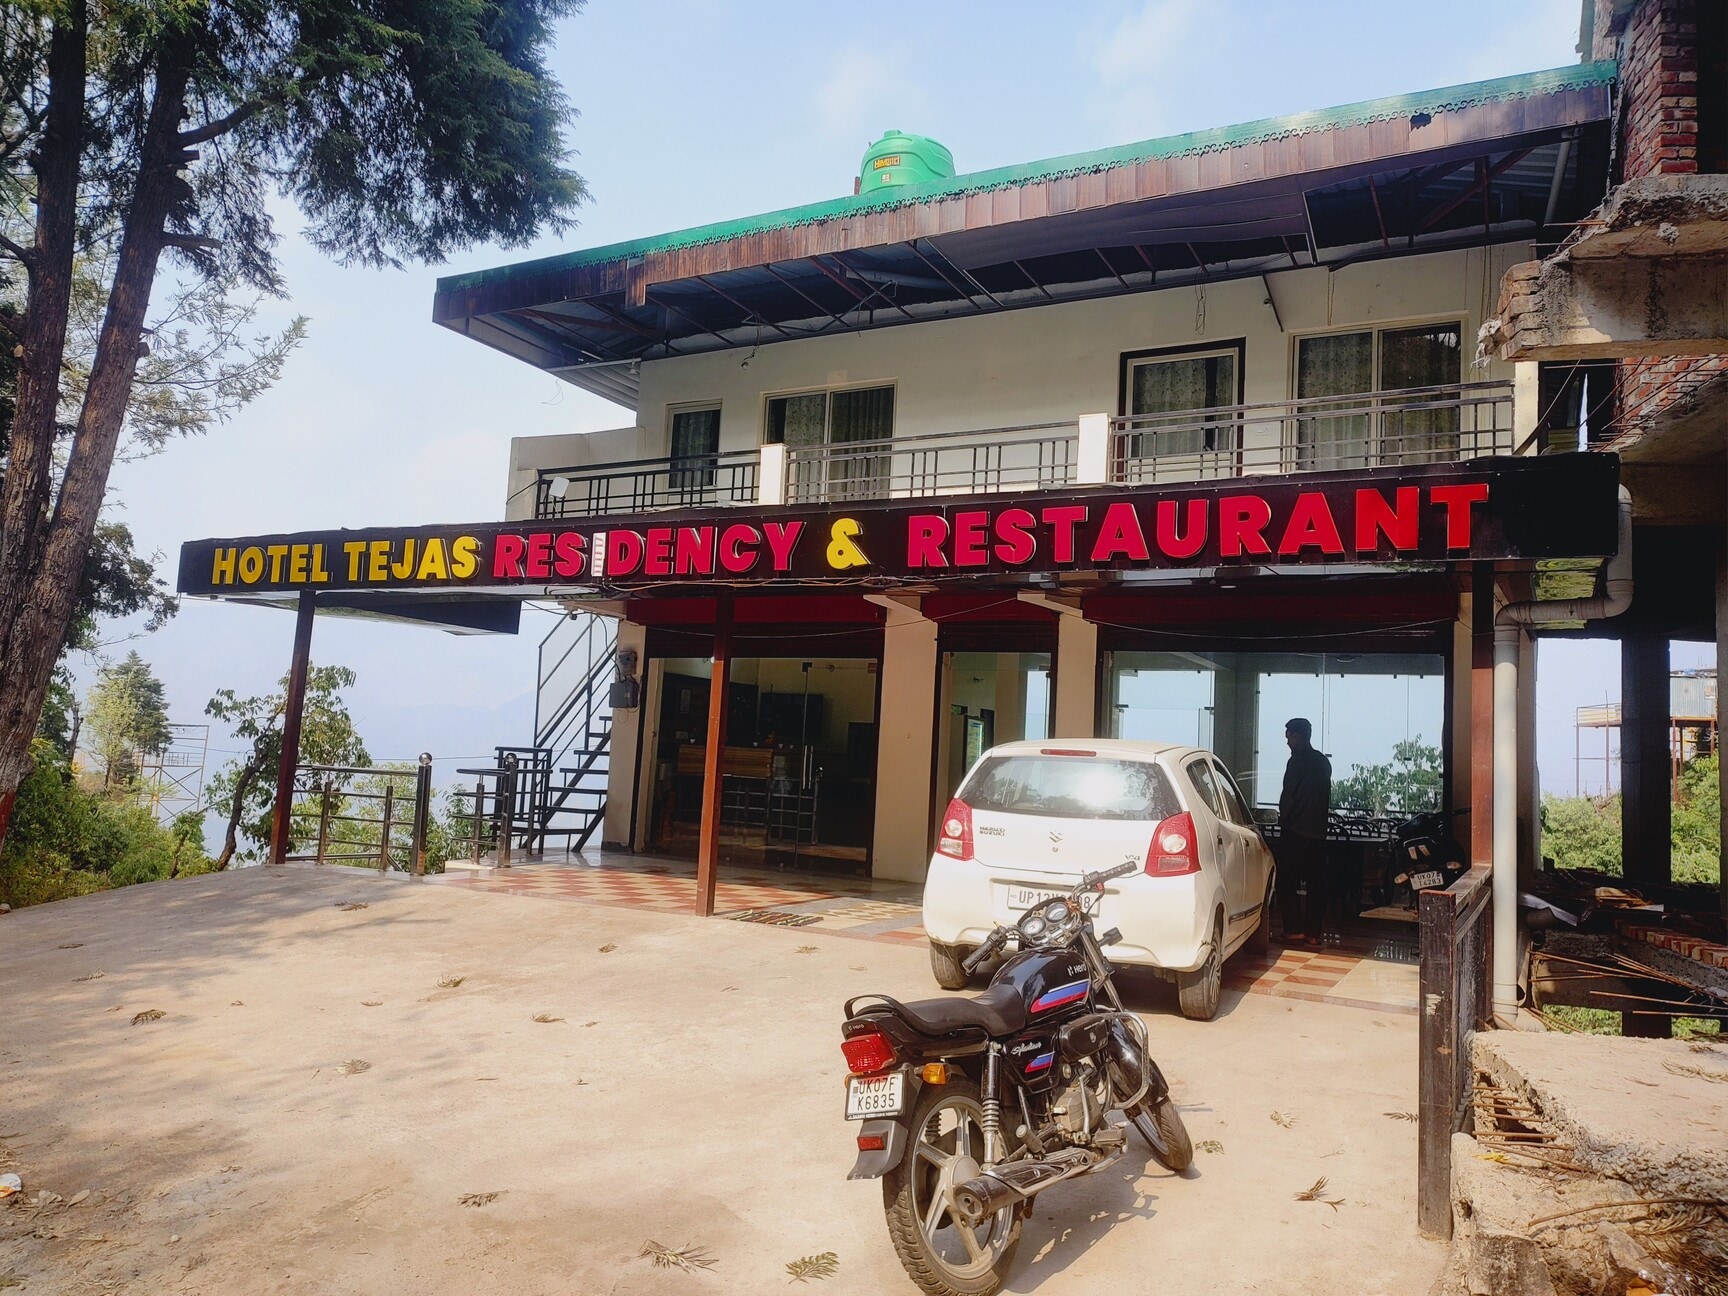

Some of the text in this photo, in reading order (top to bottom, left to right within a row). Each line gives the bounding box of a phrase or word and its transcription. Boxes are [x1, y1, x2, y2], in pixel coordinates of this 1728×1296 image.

[211, 483, 1491, 586] HOTEL TEJAS RESIDENCY & RESTAURANT
[858, 1076, 897, 1095] UK07F
[857, 1093, 895, 1111] K6835
